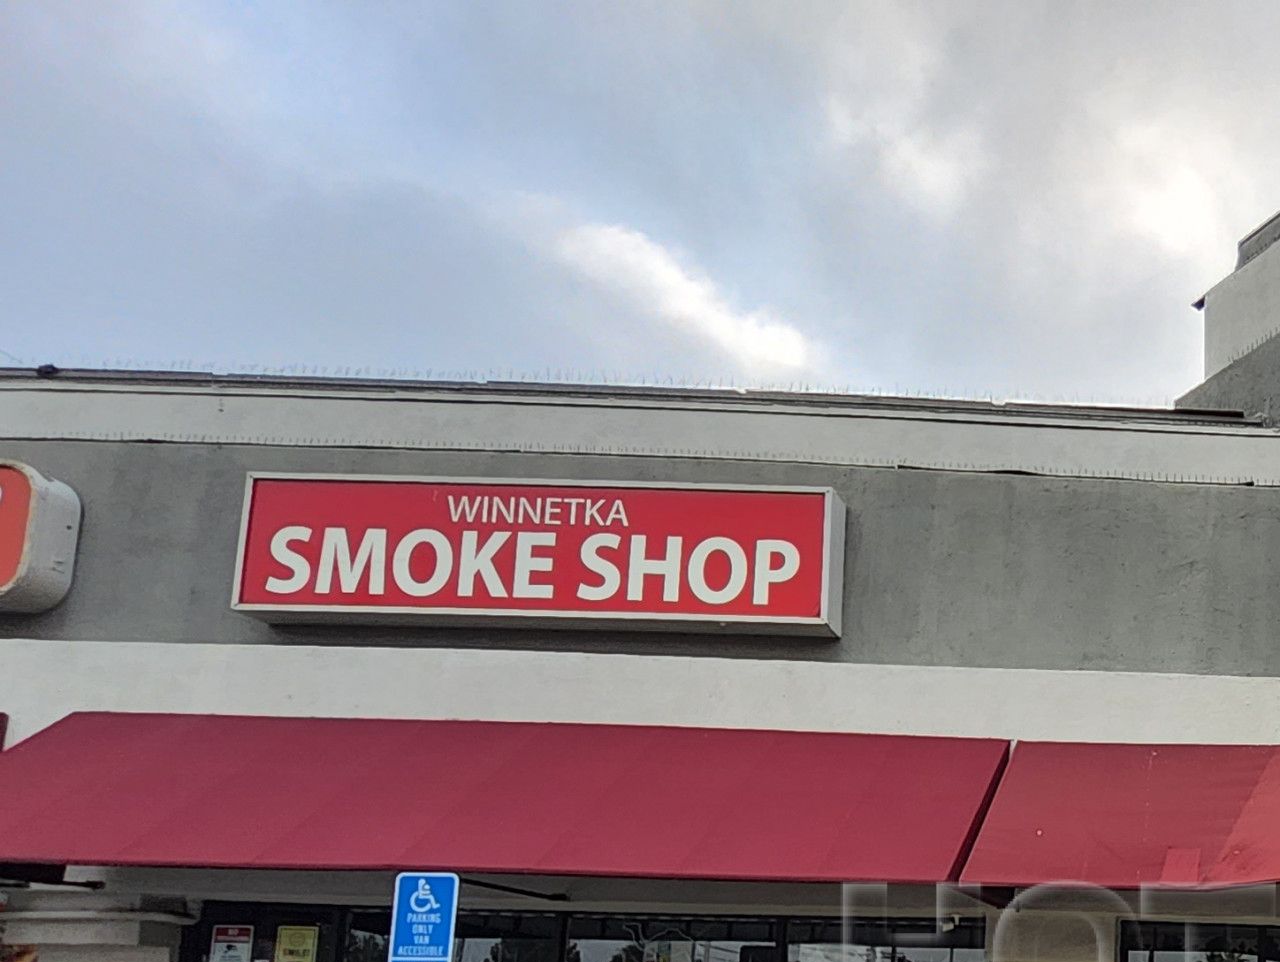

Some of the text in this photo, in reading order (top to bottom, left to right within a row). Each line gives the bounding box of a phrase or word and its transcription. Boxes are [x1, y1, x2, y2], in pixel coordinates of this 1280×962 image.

[447, 495, 629, 527] WINNETKA
[264, 525, 802, 606] SMOKE SHOP
[406, 912, 442, 924] PARKING
[411, 924, 434, 935] ONLY
[413, 935, 430, 945] VAN
[397, 946, 444, 956] ACCESSIBLE
